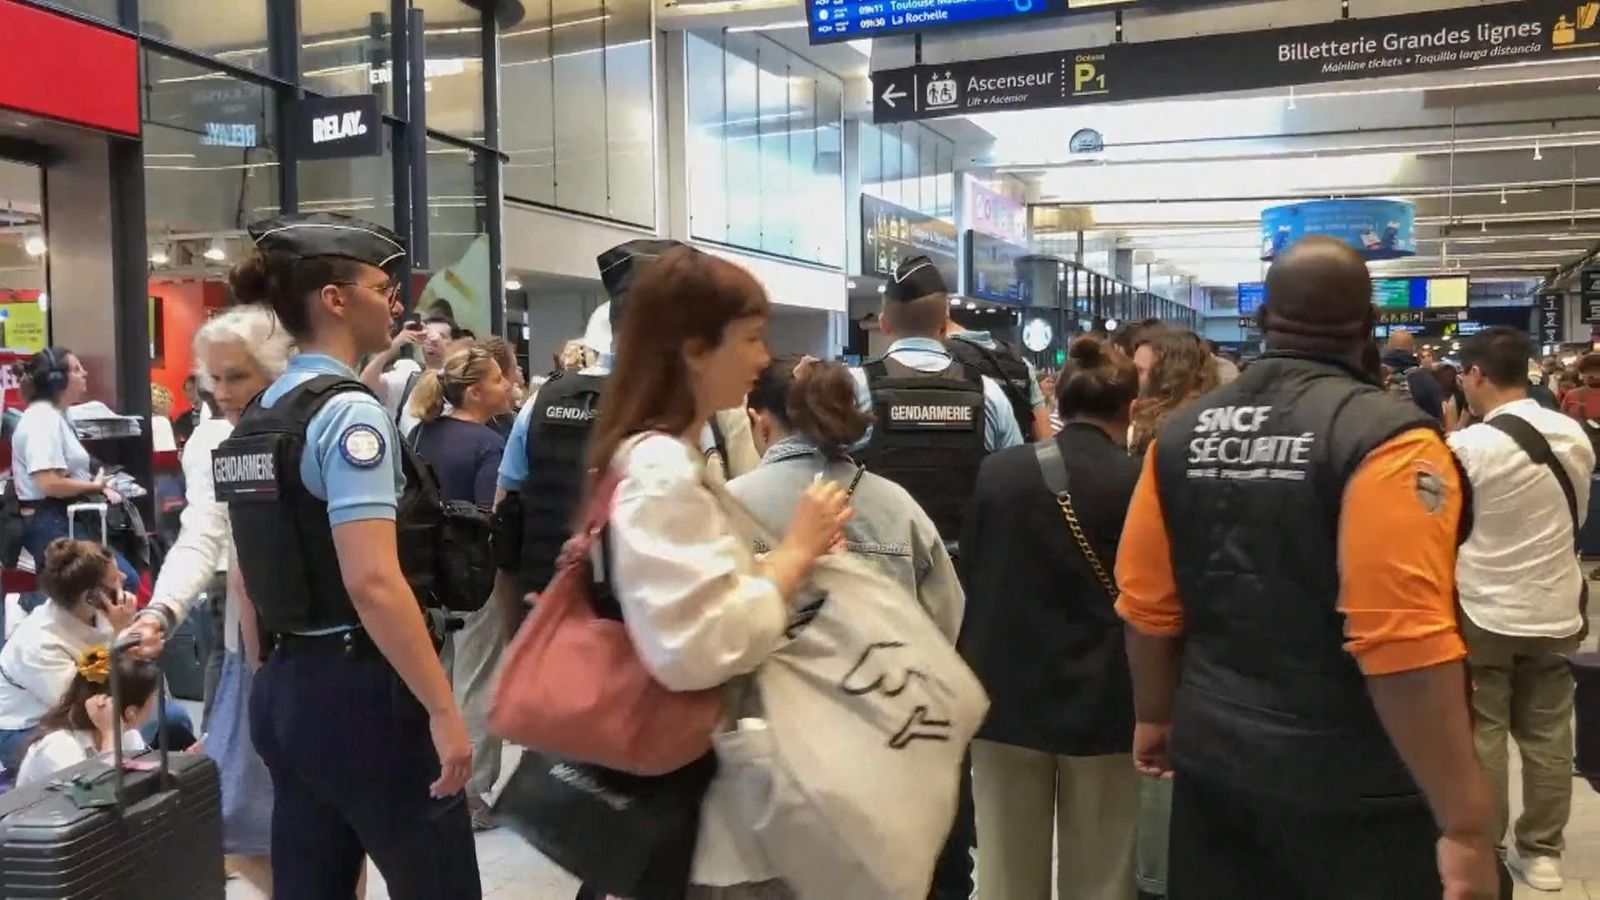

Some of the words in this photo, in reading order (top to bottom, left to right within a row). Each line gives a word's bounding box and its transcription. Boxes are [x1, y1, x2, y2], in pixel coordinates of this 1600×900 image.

[860, 17, 886, 29] 09h30
[891, 15, 904, 26] La
[905, 9, 948, 23] Rochelle
[890, 0, 935, 10] Toulouse
[1278, 37, 1377, 62] Billetterie
[1383, 27, 1470, 50] Grandes
[1477, 22, 1542, 44] lignes
[1321, 60, 1366, 73] Mainline
[1368, 57, 1402, 69] tickets
[1414, 50, 1457, 64] Taquilla
[1460, 48, 1487, 60] larga
[1490, 42, 1541, 56] distancia
[967, 72, 1055, 92] Ascenseur
[1075, 63, 1105, 91] P1
[967, 96, 982, 107] Lift
[989, 94, 1028, 105] Ascensor
[890, 405, 972, 420] GENDARMERIE
[1194, 405, 1273, 433] SNCF
[213, 452, 276, 483] GENDARMERIE
